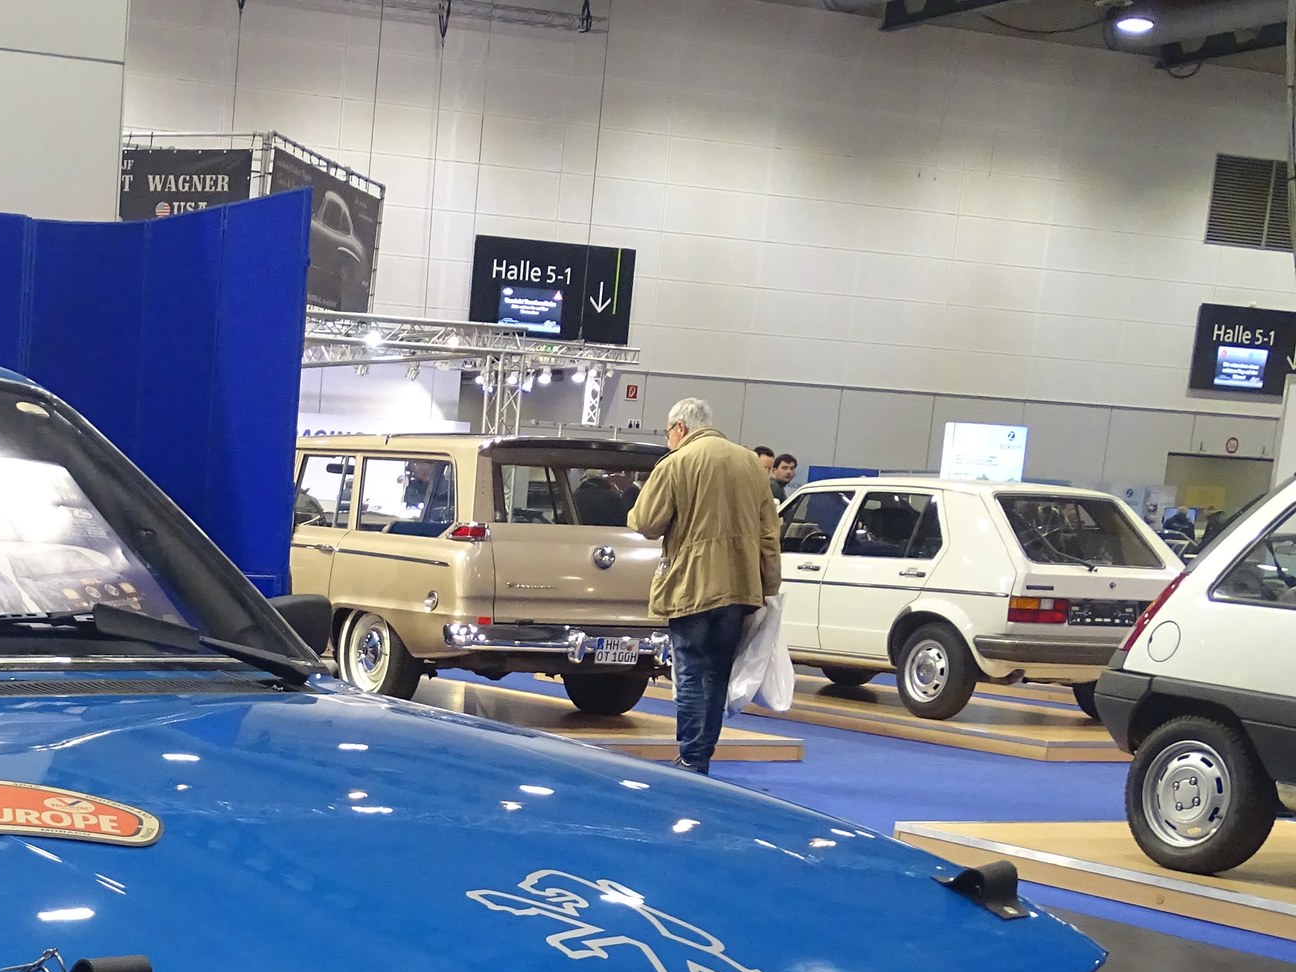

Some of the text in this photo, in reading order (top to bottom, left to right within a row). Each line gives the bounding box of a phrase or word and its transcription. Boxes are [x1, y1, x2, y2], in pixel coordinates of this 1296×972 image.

[147, 174, 230, 192] WAGNER
[492, 259, 572, 284] Halle 5-1
[1213, 324, 1276, 346] Halle 5-1
[606, 639, 619, 651] HH
[597, 652, 609, 662] OT
